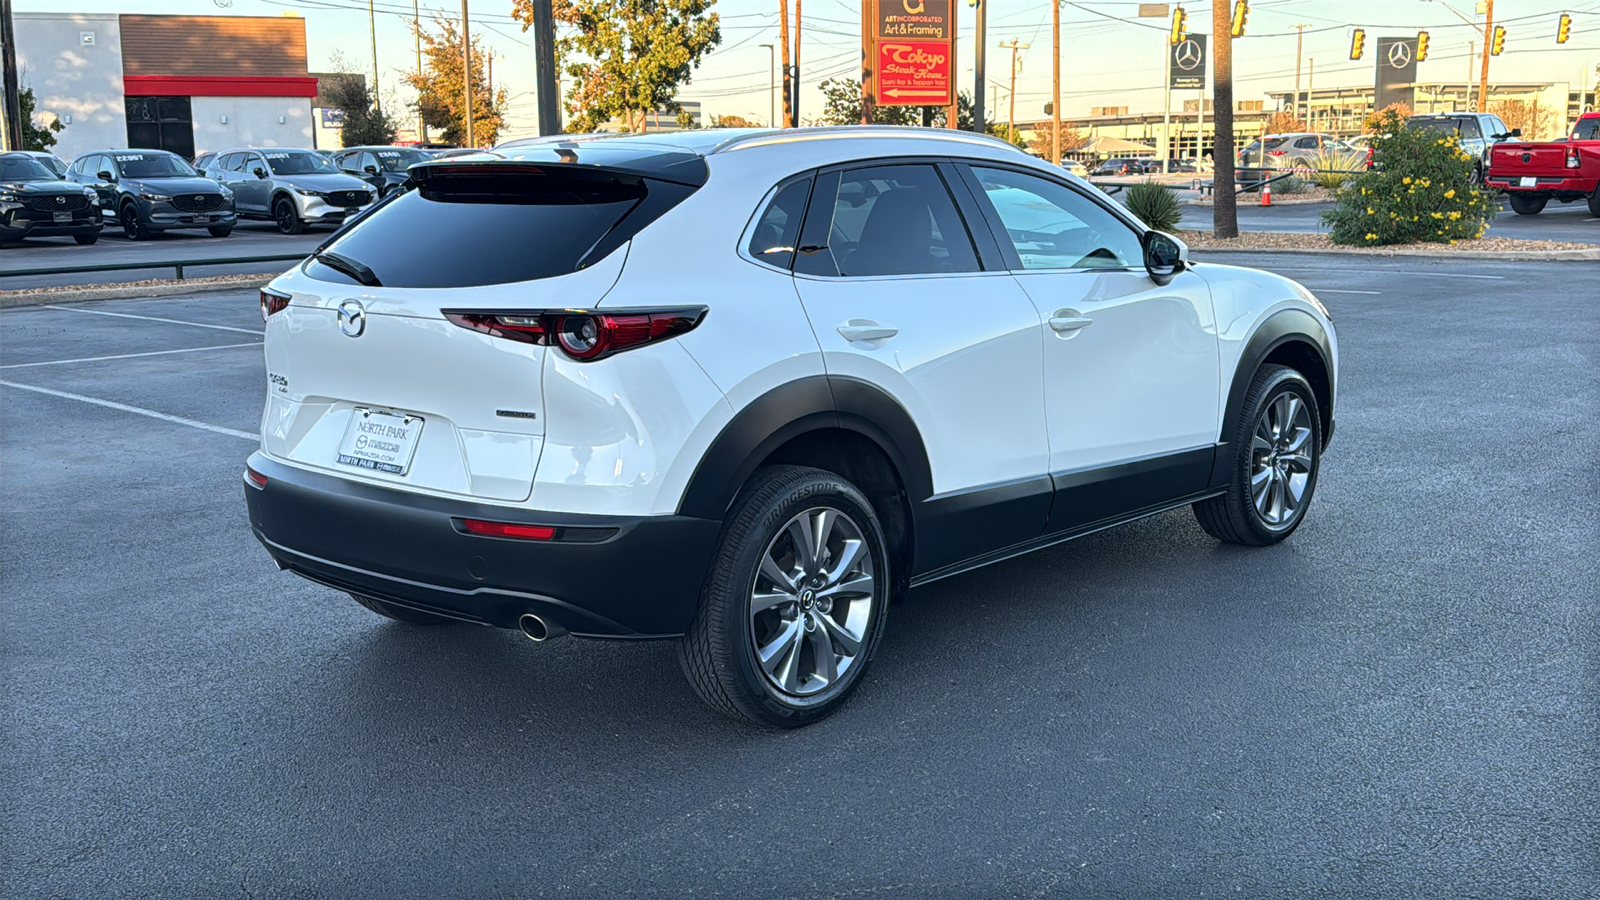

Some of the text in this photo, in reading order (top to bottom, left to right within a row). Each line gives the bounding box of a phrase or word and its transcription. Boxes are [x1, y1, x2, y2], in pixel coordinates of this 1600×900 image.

[885, 23, 943, 38] Art & Framing
[882, 44, 945, 70] Tokyo
[882, 64, 947, 79] Steak House
[357, 420, 409, 440] NORTH PARK
[340, 454, 358, 467] NORTH
[358, 458, 375, 469] PARK
[353, 450, 395, 462] NPMAZDA.COM
